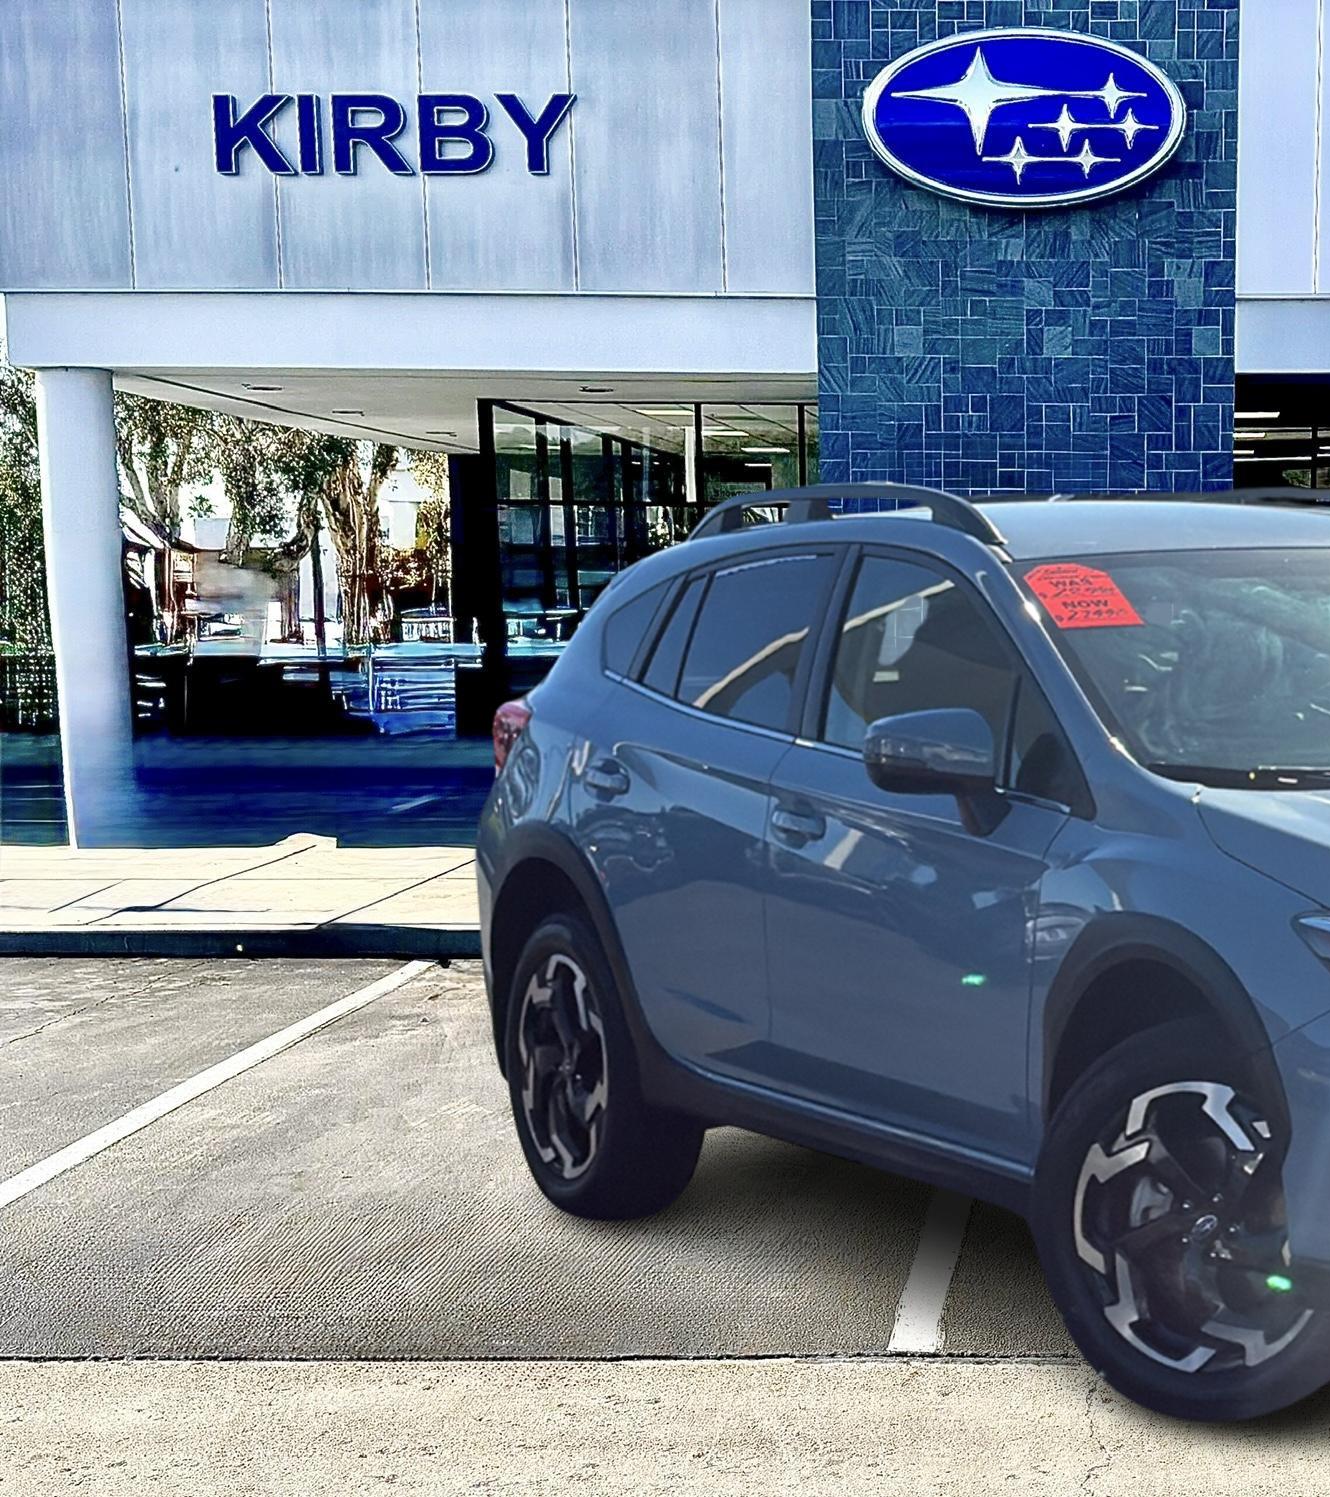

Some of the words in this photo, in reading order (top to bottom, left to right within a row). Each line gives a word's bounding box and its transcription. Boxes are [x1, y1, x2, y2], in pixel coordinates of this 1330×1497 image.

[211, 93, 577, 176] KIRBY
[1050, 576, 1093, 588] WAS
[1062, 600, 1109, 609] NOW
